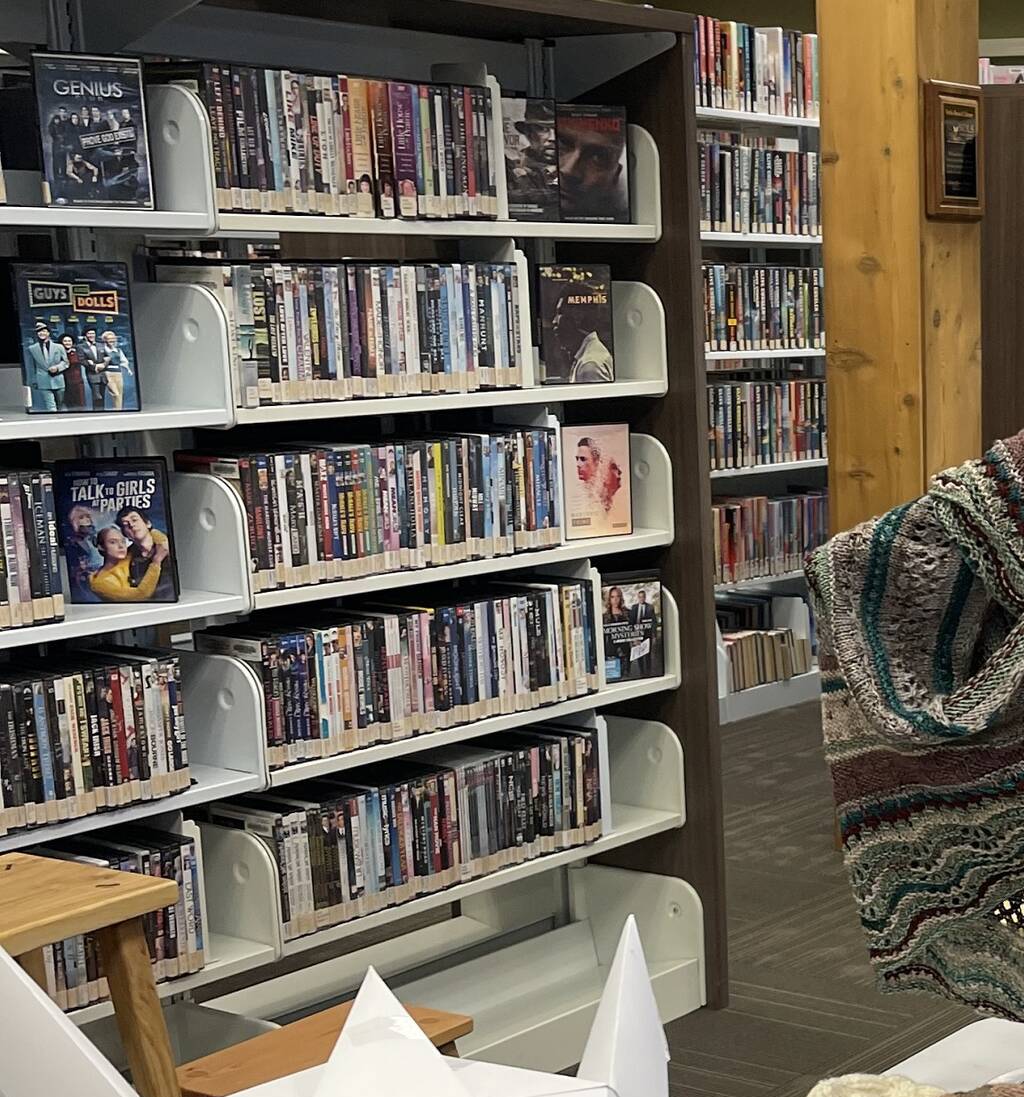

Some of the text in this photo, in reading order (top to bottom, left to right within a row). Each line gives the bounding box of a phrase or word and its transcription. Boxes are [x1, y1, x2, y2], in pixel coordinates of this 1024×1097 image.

[53, 80, 123, 97] GENIUS
[214, 82, 225, 138] LEFT BEHIND
[286, 90, 294, 123] LIKE
[236, 110, 244, 136] FILM
[34, 287, 67, 300] GUYS
[77, 296, 115, 308] DOLLS
[568, 294, 607, 304] MEMPHIS
[254, 291, 266, 322] LOST
[478, 299, 487, 352] MANHUNT
[70, 484, 105, 502] TALK
[116, 478, 155, 496] GIRLS
[100, 495, 151, 512] PARTIES
[408, 470, 416, 537] MELANCHOLIA
[34, 502, 46, 544] ICEMAN
[48, 521, 57, 546] Ideal
[603, 625, 633, 634] MORNING
[611, 631, 644, 639] MYSTERIES
[90, 715, 98, 734] JACK
[138, 707, 146, 757] JAMESTOWN
[150, 735, 158, 769] BOURNE
[185, 882, 195, 934] LAST WORD
